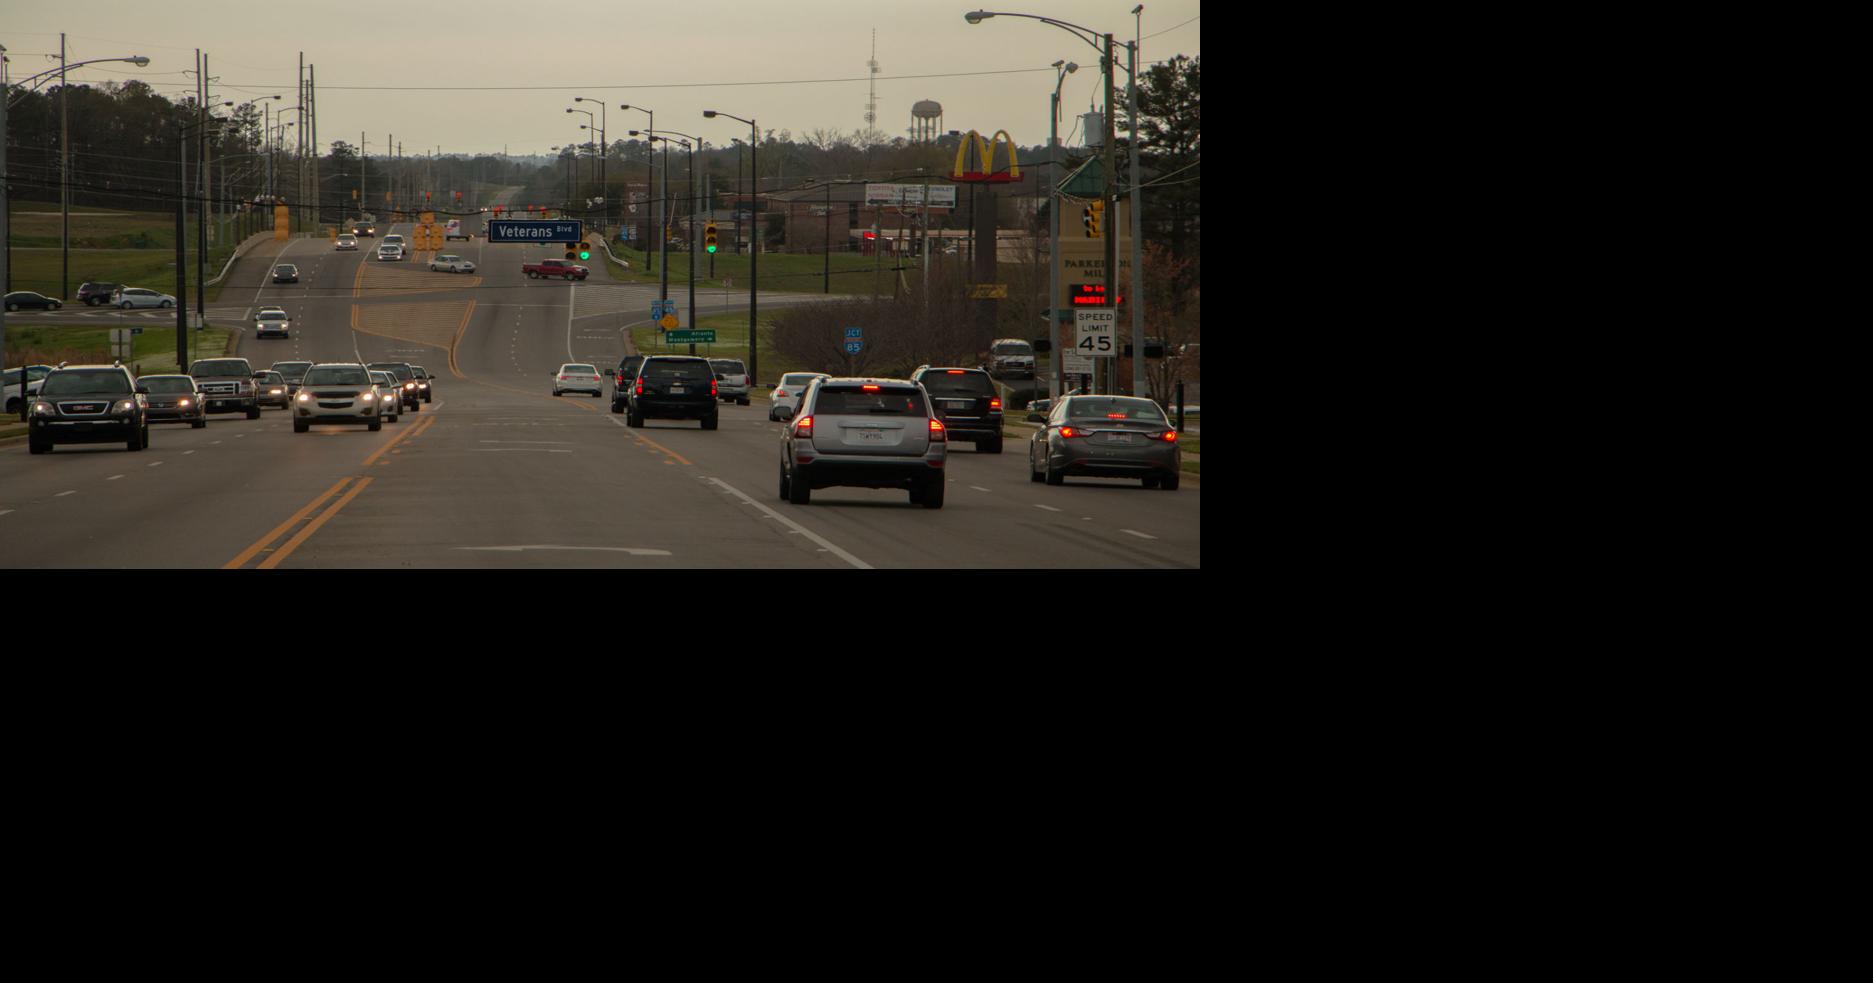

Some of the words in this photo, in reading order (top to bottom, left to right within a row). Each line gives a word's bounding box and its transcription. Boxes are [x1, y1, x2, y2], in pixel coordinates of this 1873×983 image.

[500, 225, 553, 237] Veterans
[847, 343, 861, 352] 85
[1079, 336, 1111, 351] 45
